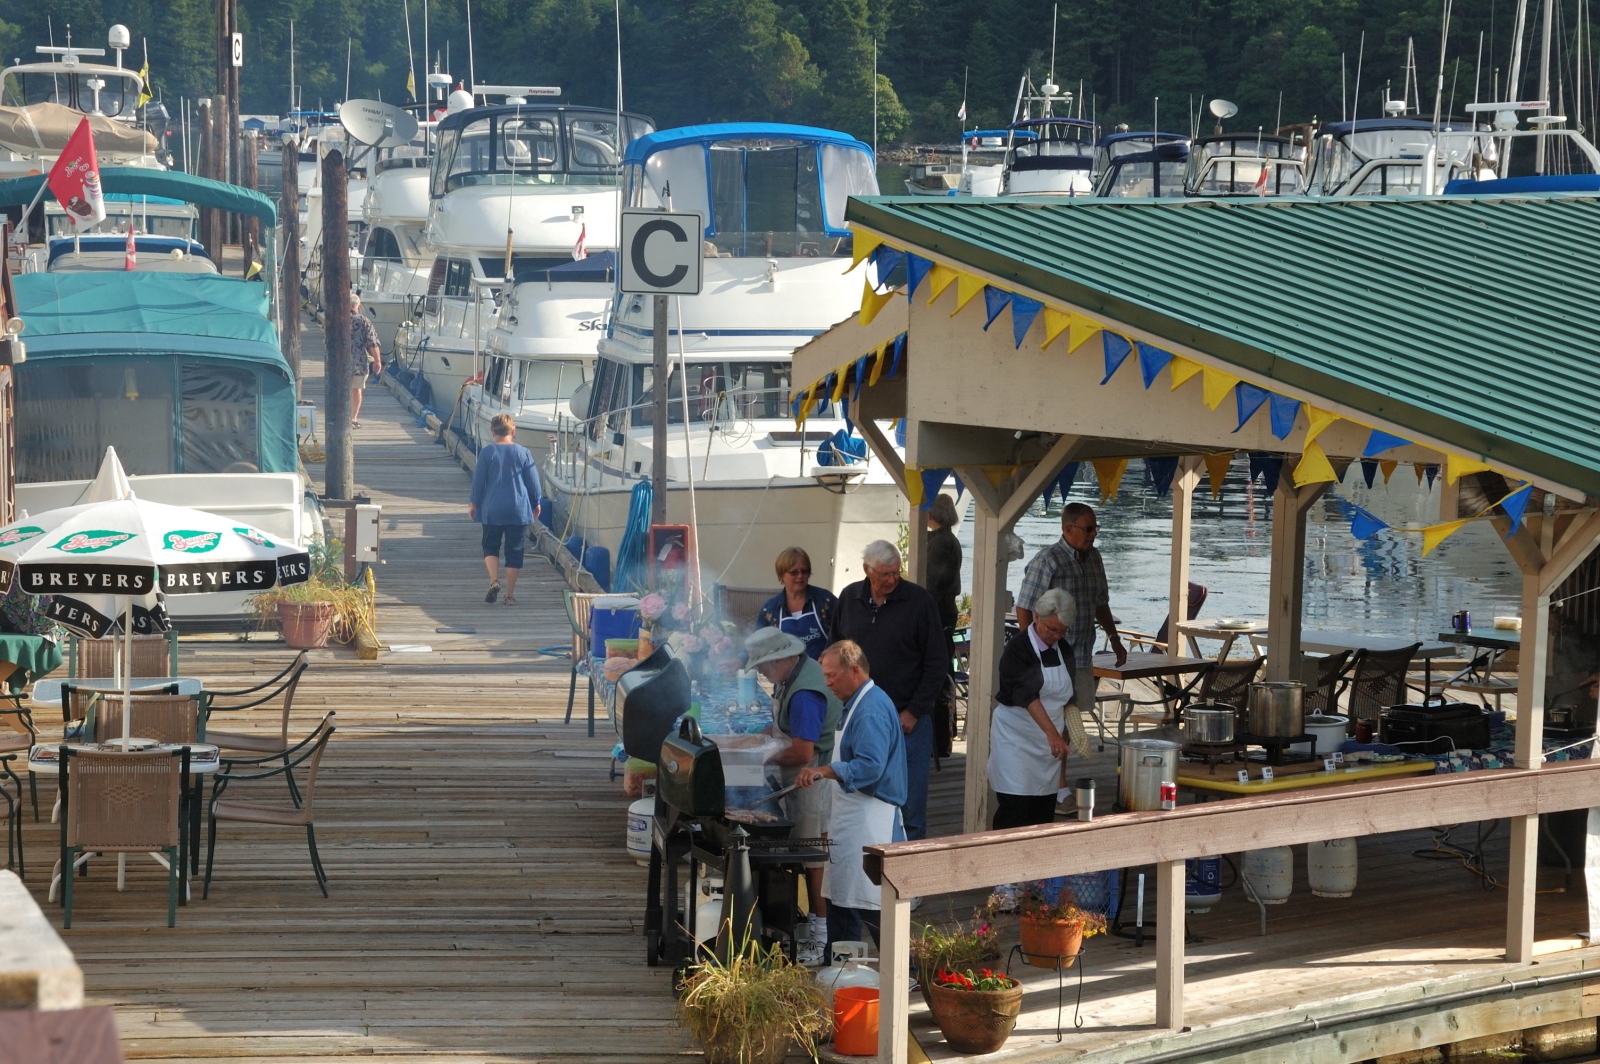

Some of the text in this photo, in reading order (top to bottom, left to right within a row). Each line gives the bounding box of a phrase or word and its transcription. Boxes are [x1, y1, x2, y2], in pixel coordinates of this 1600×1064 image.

[234, 38, 241, 61] C
[630, 219, 689, 288] C
[61, 533, 129, 551] Breyers
[168, 531, 218, 551] Breyers
[31, 572, 144, 589] BREYERS
[167, 570, 265, 587] BREYERS
